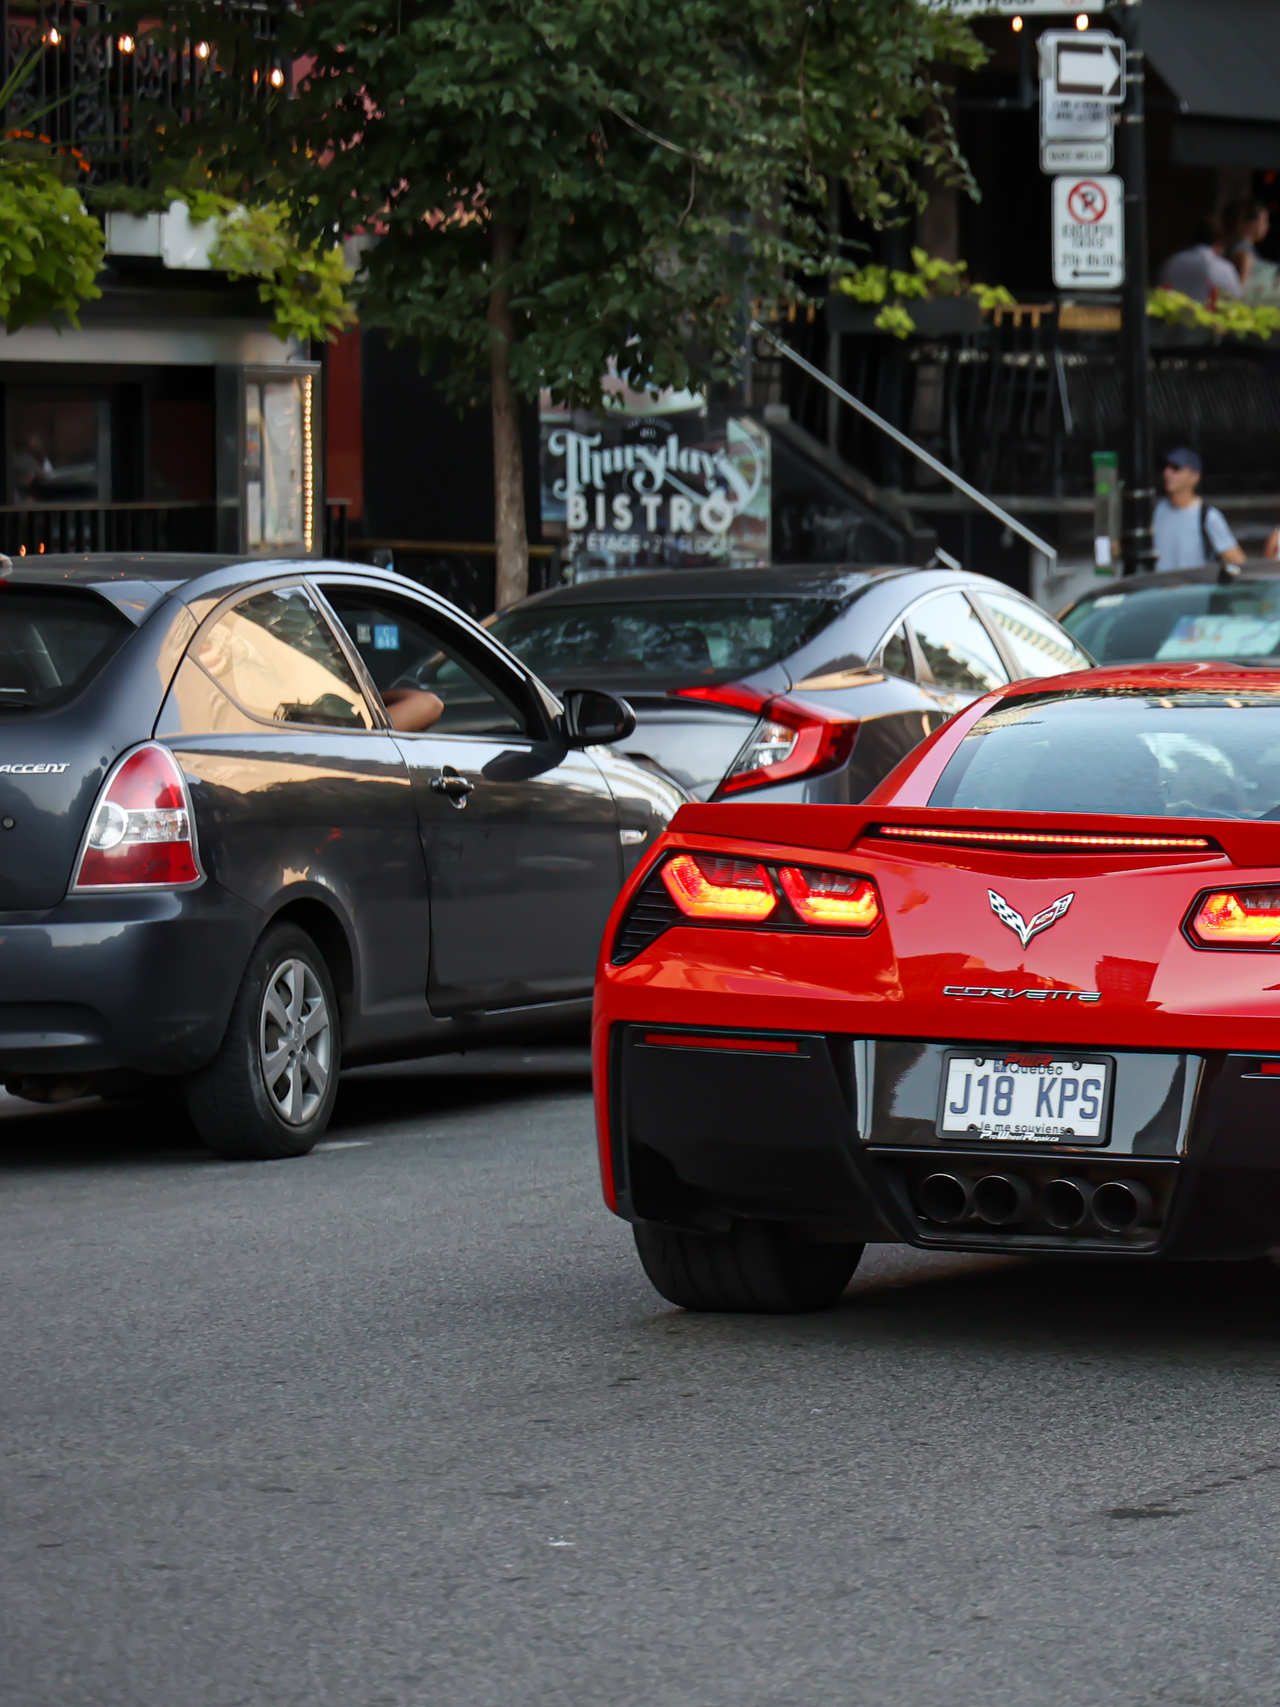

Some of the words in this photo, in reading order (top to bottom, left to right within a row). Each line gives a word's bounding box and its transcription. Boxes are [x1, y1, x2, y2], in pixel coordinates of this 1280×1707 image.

[567, 493, 734, 533] BISTRO
[586, 531, 642, 553] ÉTAGE
[0, 763, 71, 774] ACCENT
[943, 985, 1102, 1001] CORVETTE
[950, 1073, 1015, 1116] J18
[1035, 1077, 1101, 1119] KPS
[995, 1123, 1011, 1132] me
[1015, 1123, 1065, 1134] souviens
